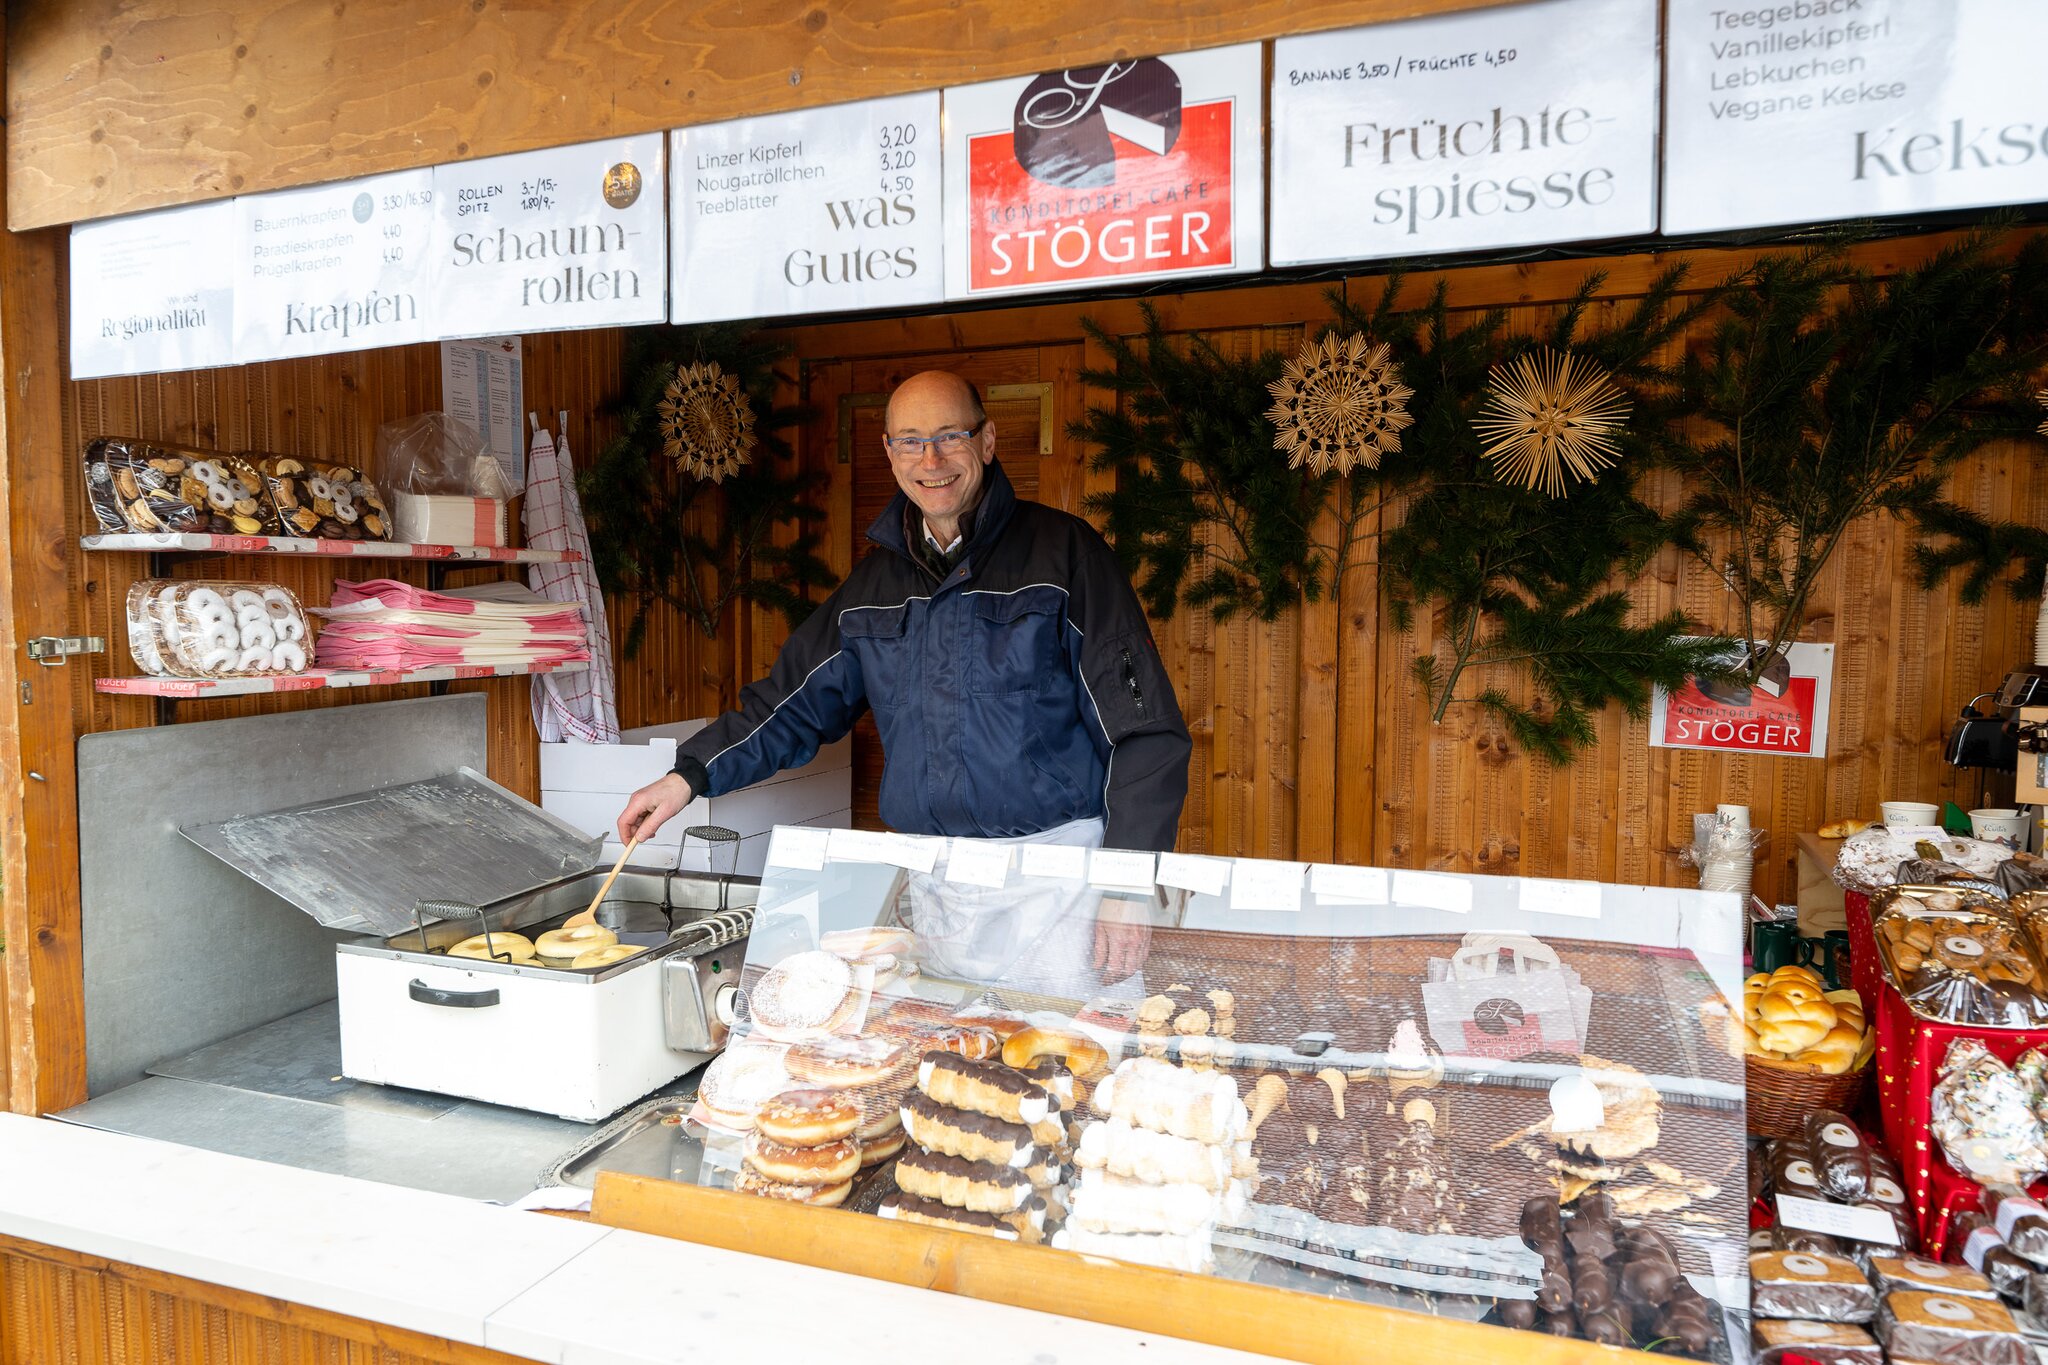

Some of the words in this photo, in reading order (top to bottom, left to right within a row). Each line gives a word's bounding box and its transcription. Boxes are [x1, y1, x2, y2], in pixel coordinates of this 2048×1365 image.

[1710, 17, 1890, 60] Vanillekipferl
[1289, 67, 1351, 86] BANANE
[1408, 53, 1477, 73] FRÜCHTE
[1711, 54, 1866, 91] Lebkuchen
[1709, 92, 1813, 121] Vegane
[1821, 79, 1908, 108] Kekse
[1342, 103, 1616, 168] Früchte-
[1850, 117, 2048, 182] Keks
[696, 149, 744, 170] Linzer
[749, 140, 803, 164] Kipferl
[458, 184, 503, 202] ROLLEN
[696, 162, 826, 193] Nougatröllchen
[457, 202, 489, 216] SPITZ
[696, 193, 779, 217] Teeblätter
[1372, 167, 1615, 235] spiesse
[254, 207, 347, 232] Bauernkrapfen
[253, 233, 354, 259] Paradieskrapfen
[990, 211, 1211, 275] STÖGER
[784, 244, 918, 288] Gutes
[521, 265, 641, 307] rollen
[101, 308, 207, 341] Regionalität
[284, 289, 418, 339] Krapfen
[1676, 718, 1802, 748] STÖGER
